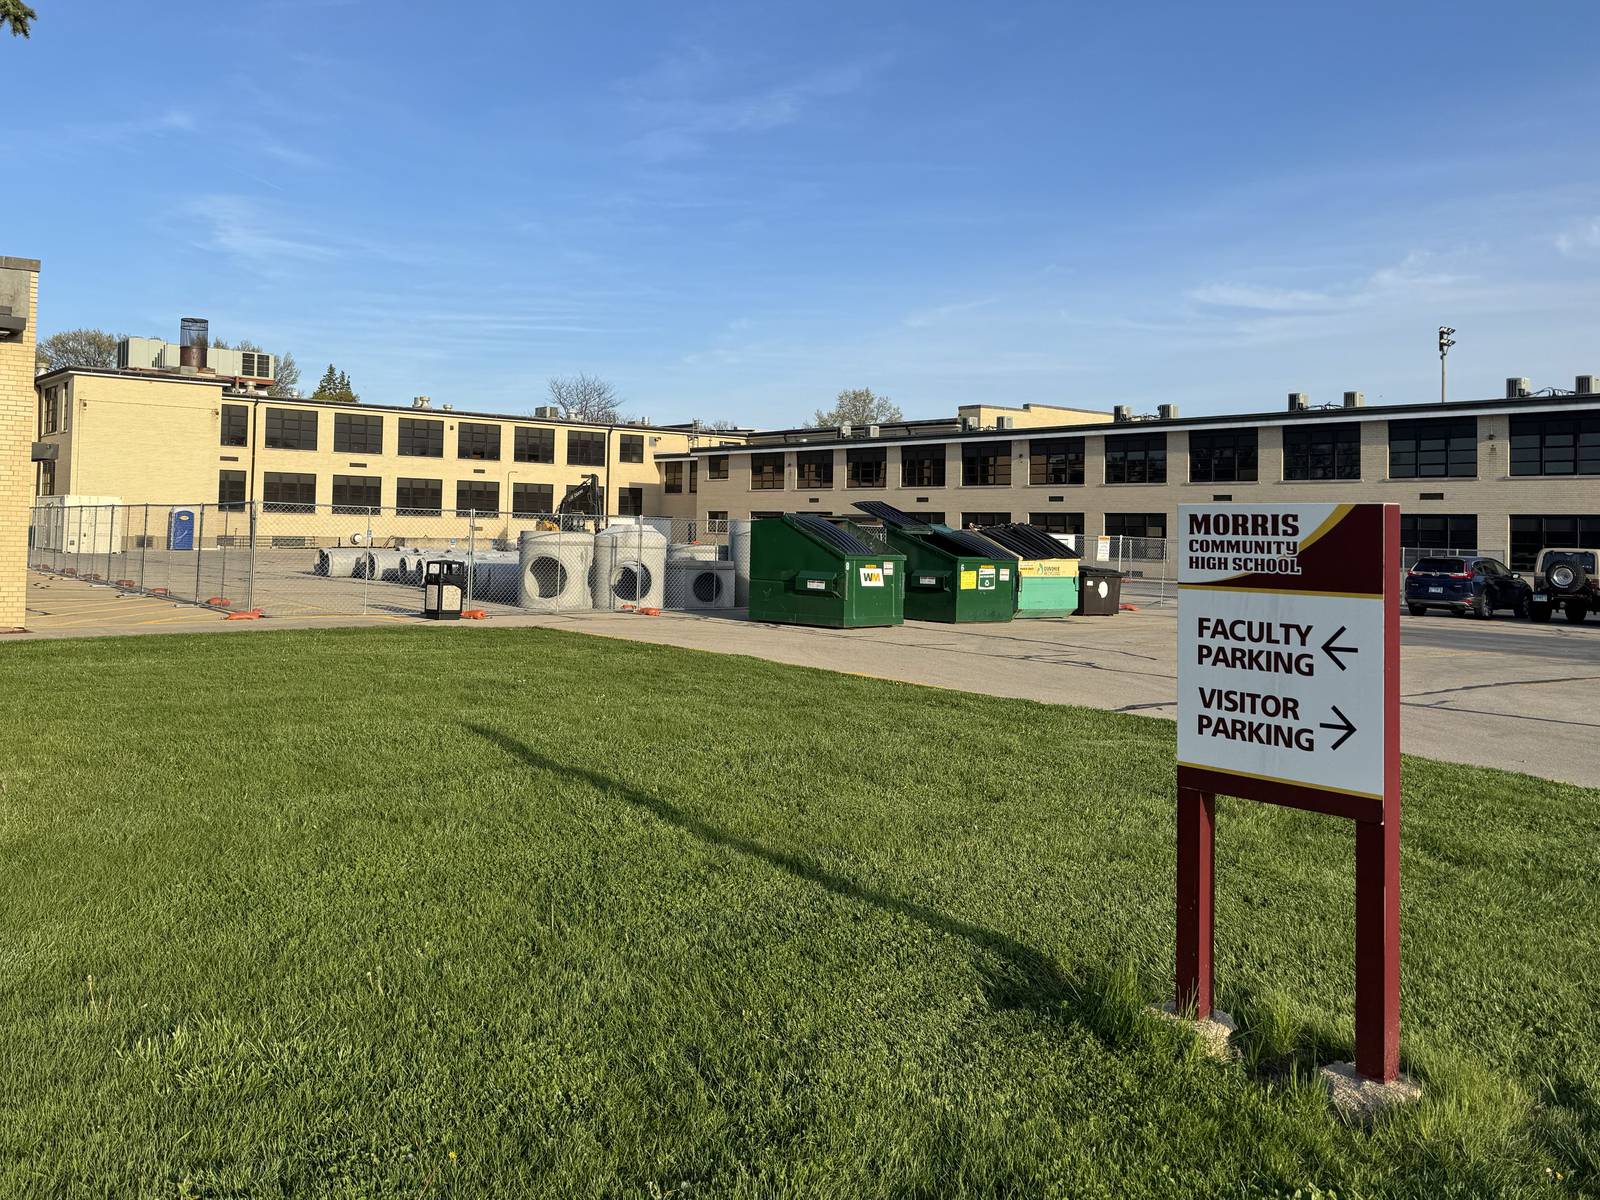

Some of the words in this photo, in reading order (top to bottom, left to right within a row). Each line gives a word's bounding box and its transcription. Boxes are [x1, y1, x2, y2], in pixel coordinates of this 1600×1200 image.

[1188, 513, 1300, 537] MORRIS
[1188, 539, 1298, 555] COMMUNITY
[863, 572, 881, 582] WM
[1188, 555, 1229, 571] HIGH
[1232, 557, 1300, 573] SCHOOL
[1197, 617, 1314, 647] FACULTY
[1197, 644, 1315, 677] PARKING
[1198, 686, 1300, 721] VISITOR
[1197, 714, 1315, 752] PARKING
